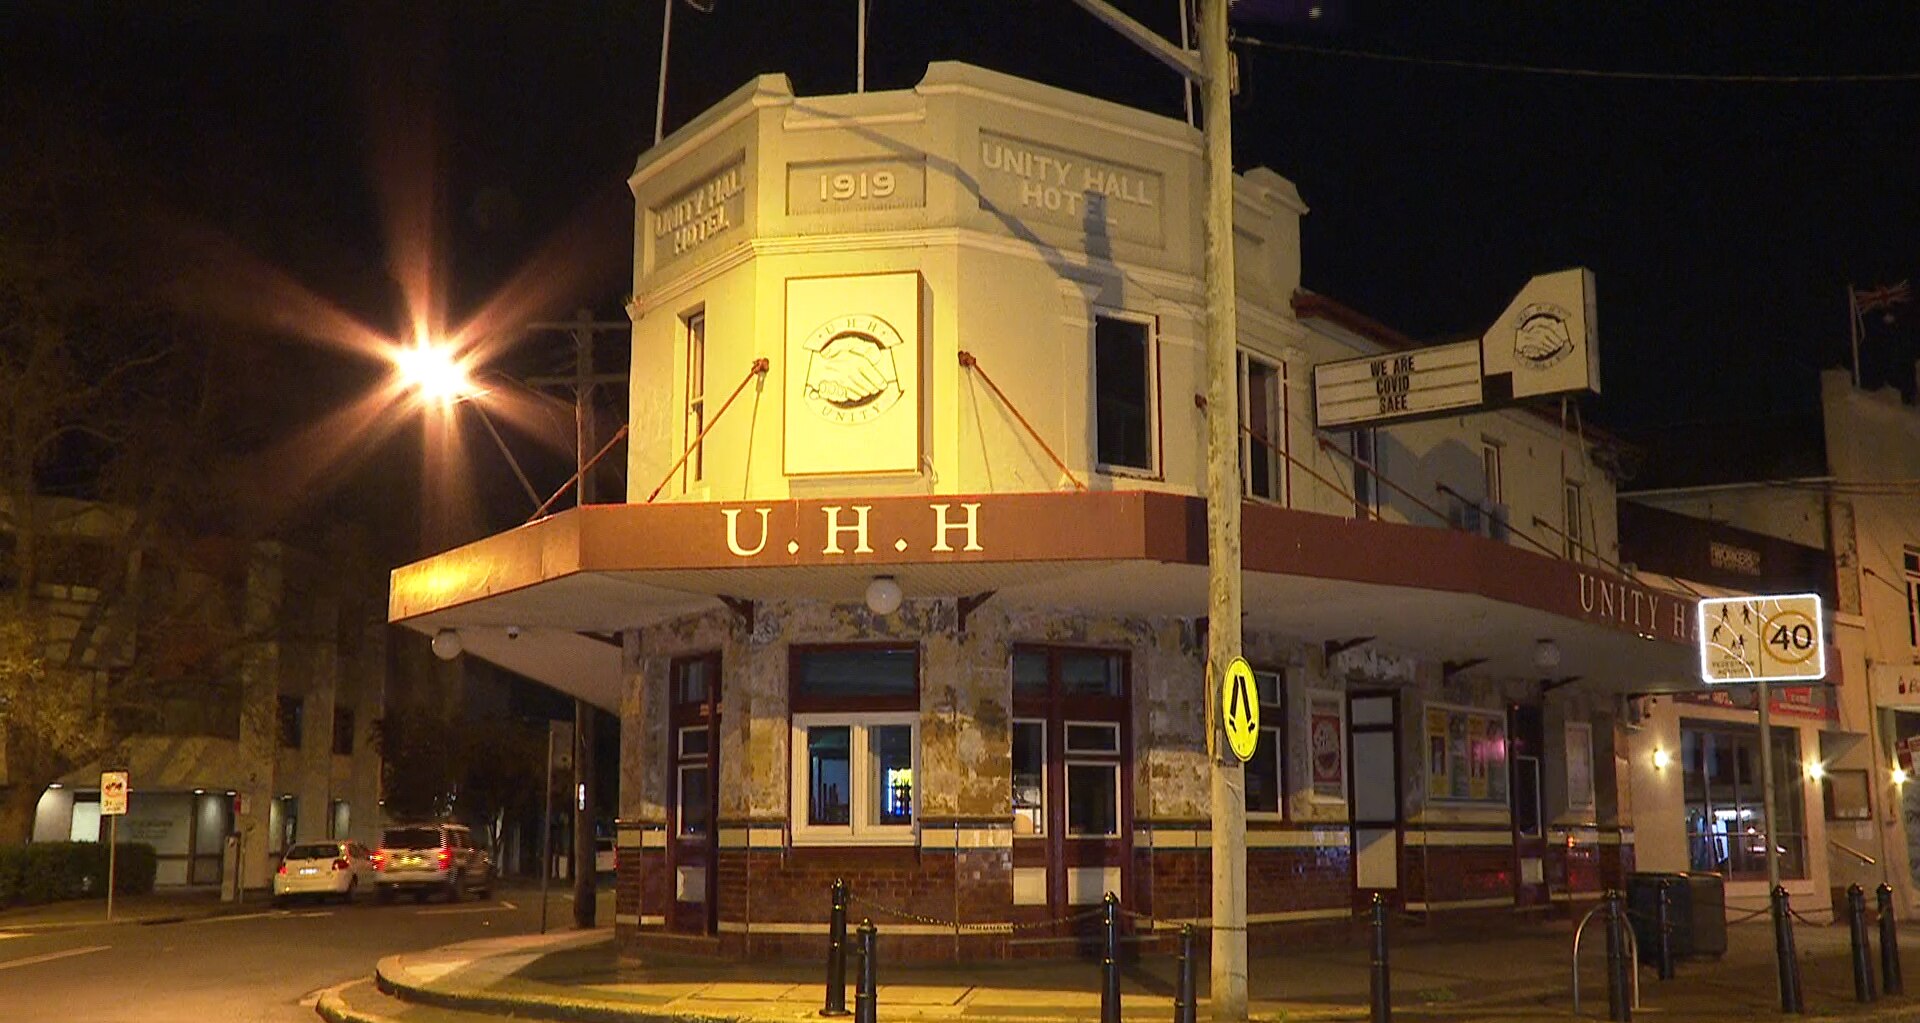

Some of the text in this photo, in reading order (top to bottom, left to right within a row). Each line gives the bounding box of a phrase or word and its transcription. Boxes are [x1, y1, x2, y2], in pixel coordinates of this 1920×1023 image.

[818, 170, 897, 202] 1919
[981, 141, 1153, 206] UNITY HALL
[655, 189, 705, 239] UNITY
[673, 206, 730, 255] HOTEL
[1370, 356, 1416, 377] WE ARE
[1376, 375, 1410, 396] COVID
[821, 404, 881, 422] UNITY
[1577, 573, 1659, 631] UNITY
[1770, 623, 1813, 651] 40
